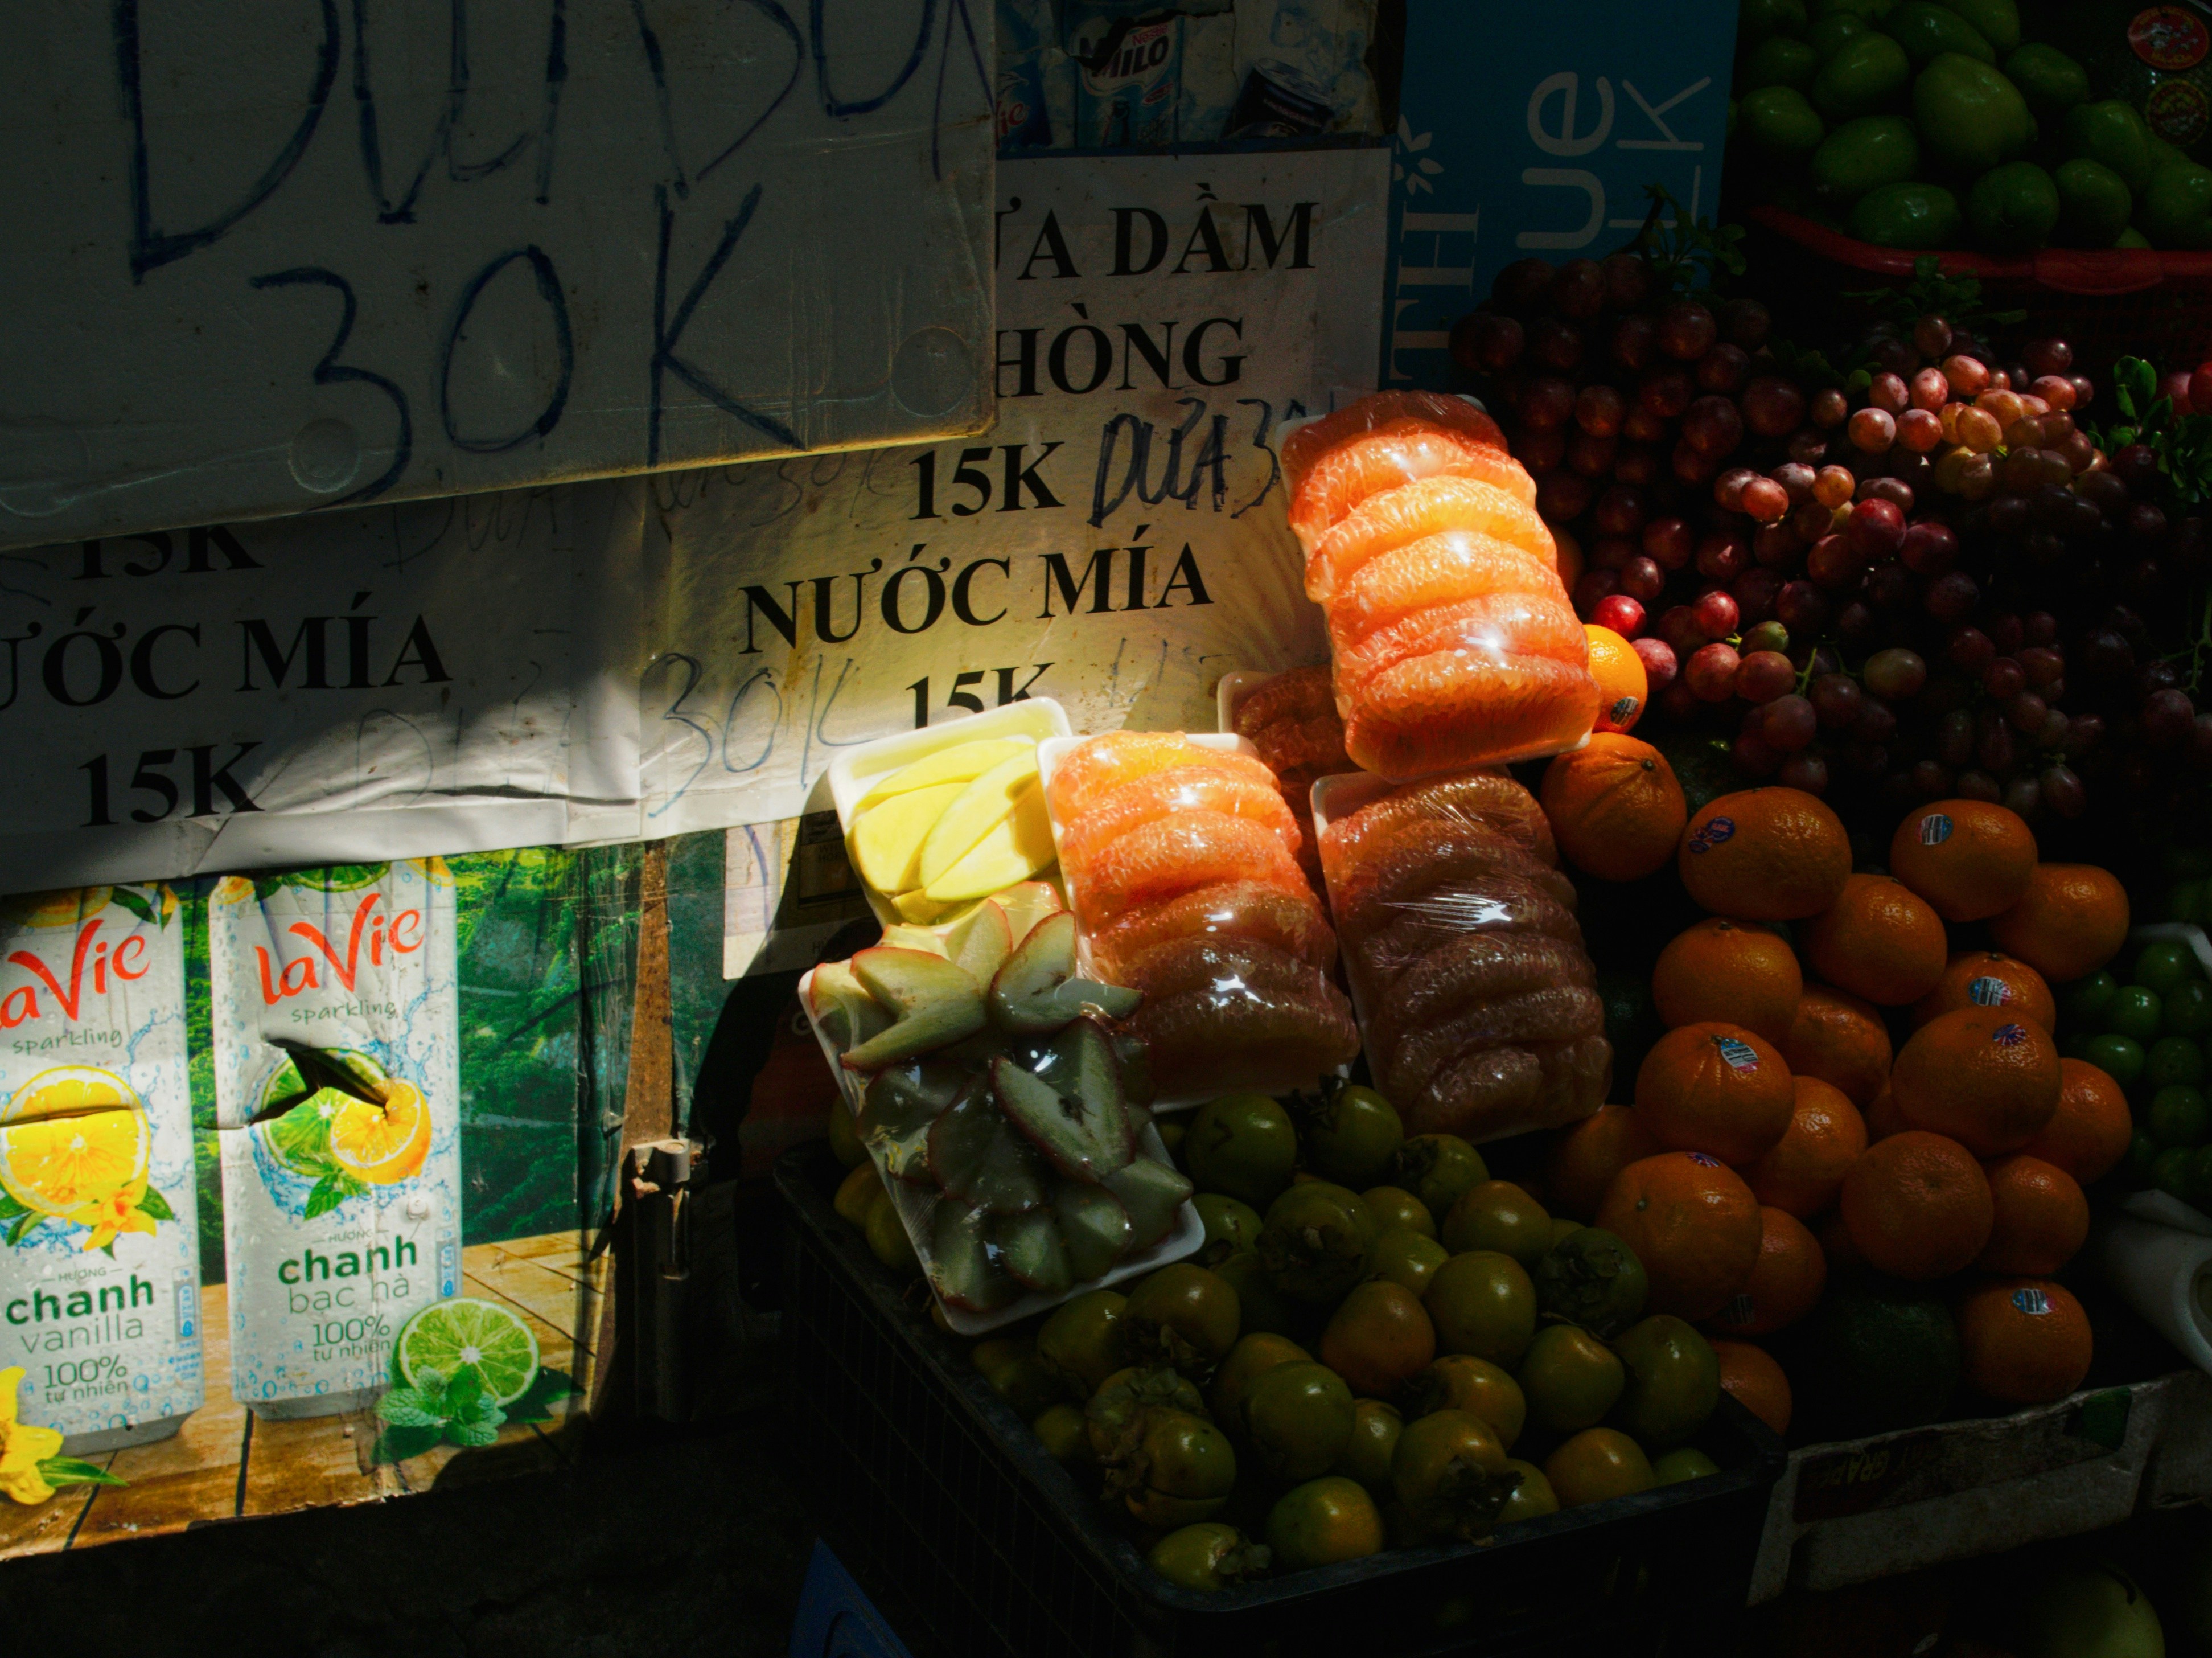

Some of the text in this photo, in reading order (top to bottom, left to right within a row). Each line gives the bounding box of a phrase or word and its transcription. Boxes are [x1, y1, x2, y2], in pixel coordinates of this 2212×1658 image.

[1515, 71, 1615, 249] ue
[996, 183, 1319, 280] A DẦM
[249, 183, 807, 514] 30K
[910, 442, 1066, 520] 15K
[739, 525, 1215, 655] NƯỚC MÍA
[235, 592, 453, 691] MÍA
[79, 742, 265, 827] 15K
[291, 1000, 398, 1024] sparkling
[13, 1027, 124, 1055] sparkling
[278, 1234, 417, 1285] chanh
[5, 1273, 154, 1325] chanh
[289, 1273, 410, 1316] bạc hà
[20, 1313, 143, 1354] vanilla
[313, 1314, 390, 1347] 100%
[339, 1338, 391, 1359] nhiên
[44, 1355, 128, 1389] 100%
[73, 1378, 129, 1400] nhiên
